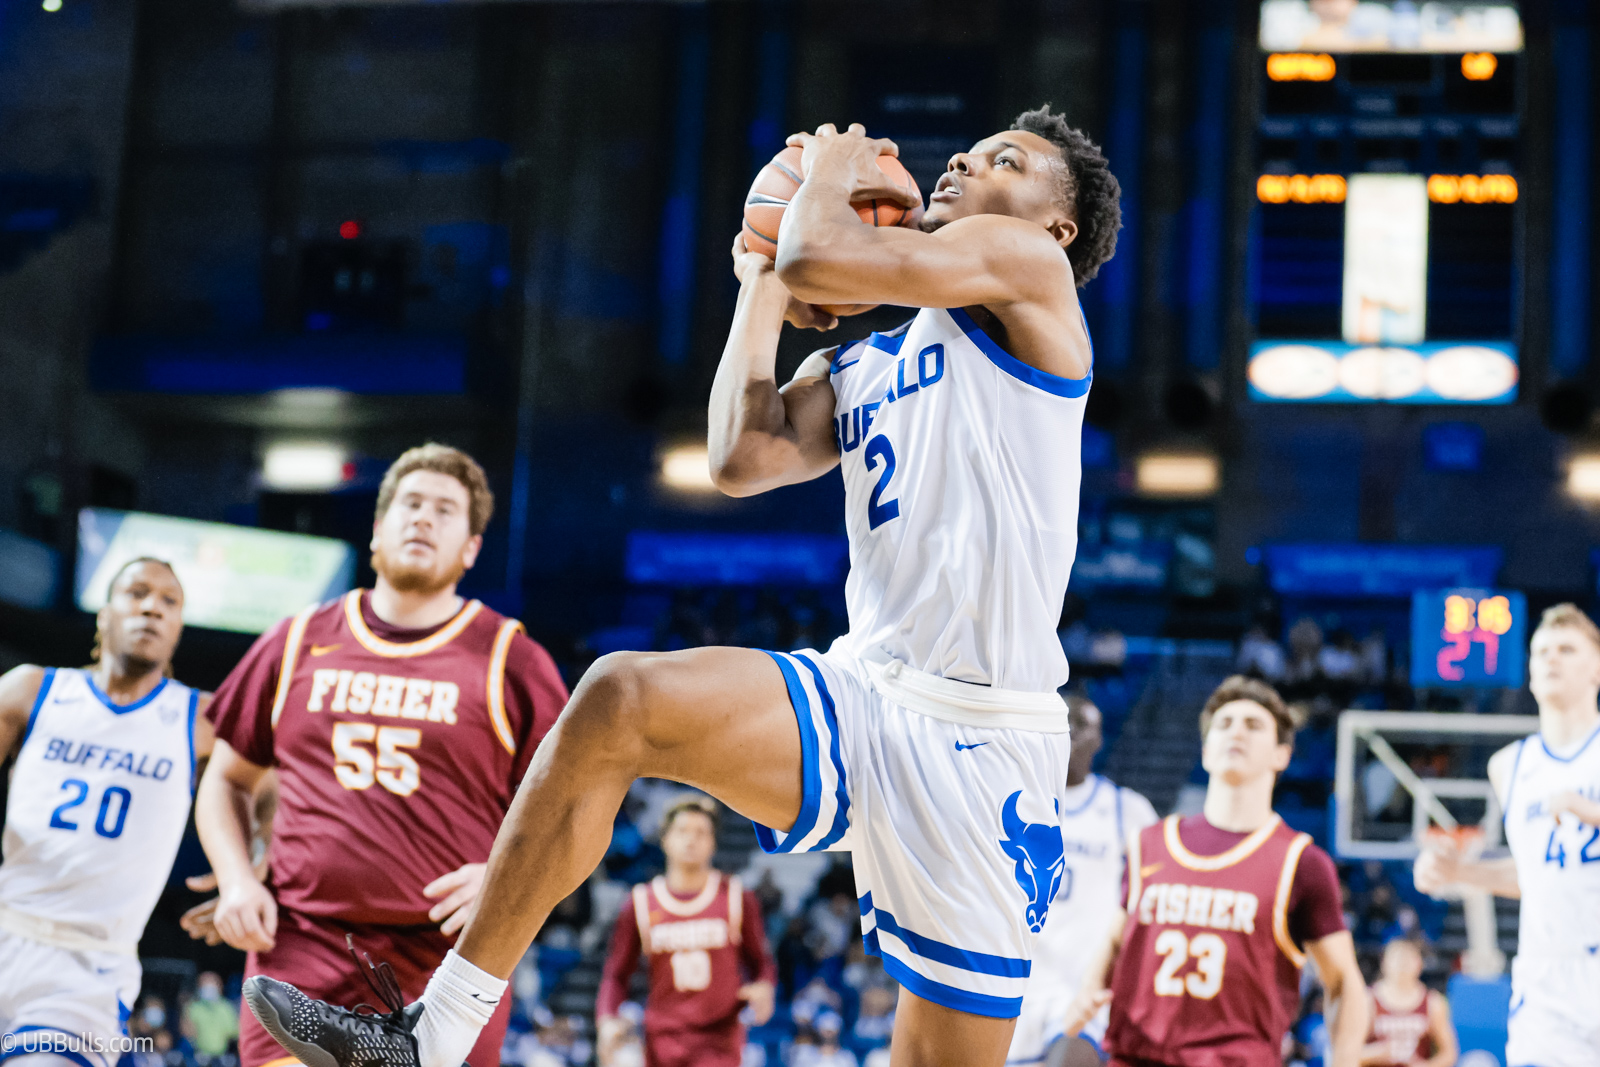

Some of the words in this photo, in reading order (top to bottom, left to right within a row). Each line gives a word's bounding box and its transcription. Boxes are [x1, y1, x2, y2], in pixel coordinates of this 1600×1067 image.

[864, 433, 900, 531] 2
[306, 668, 460, 726] FISHER
[44, 737, 174, 782] BUFFALO
[331, 721, 423, 797] 55
[49, 777, 132, 839] 20
[1139, 883, 1259, 935] FISHER
[1154, 929, 1227, 1001] 23
